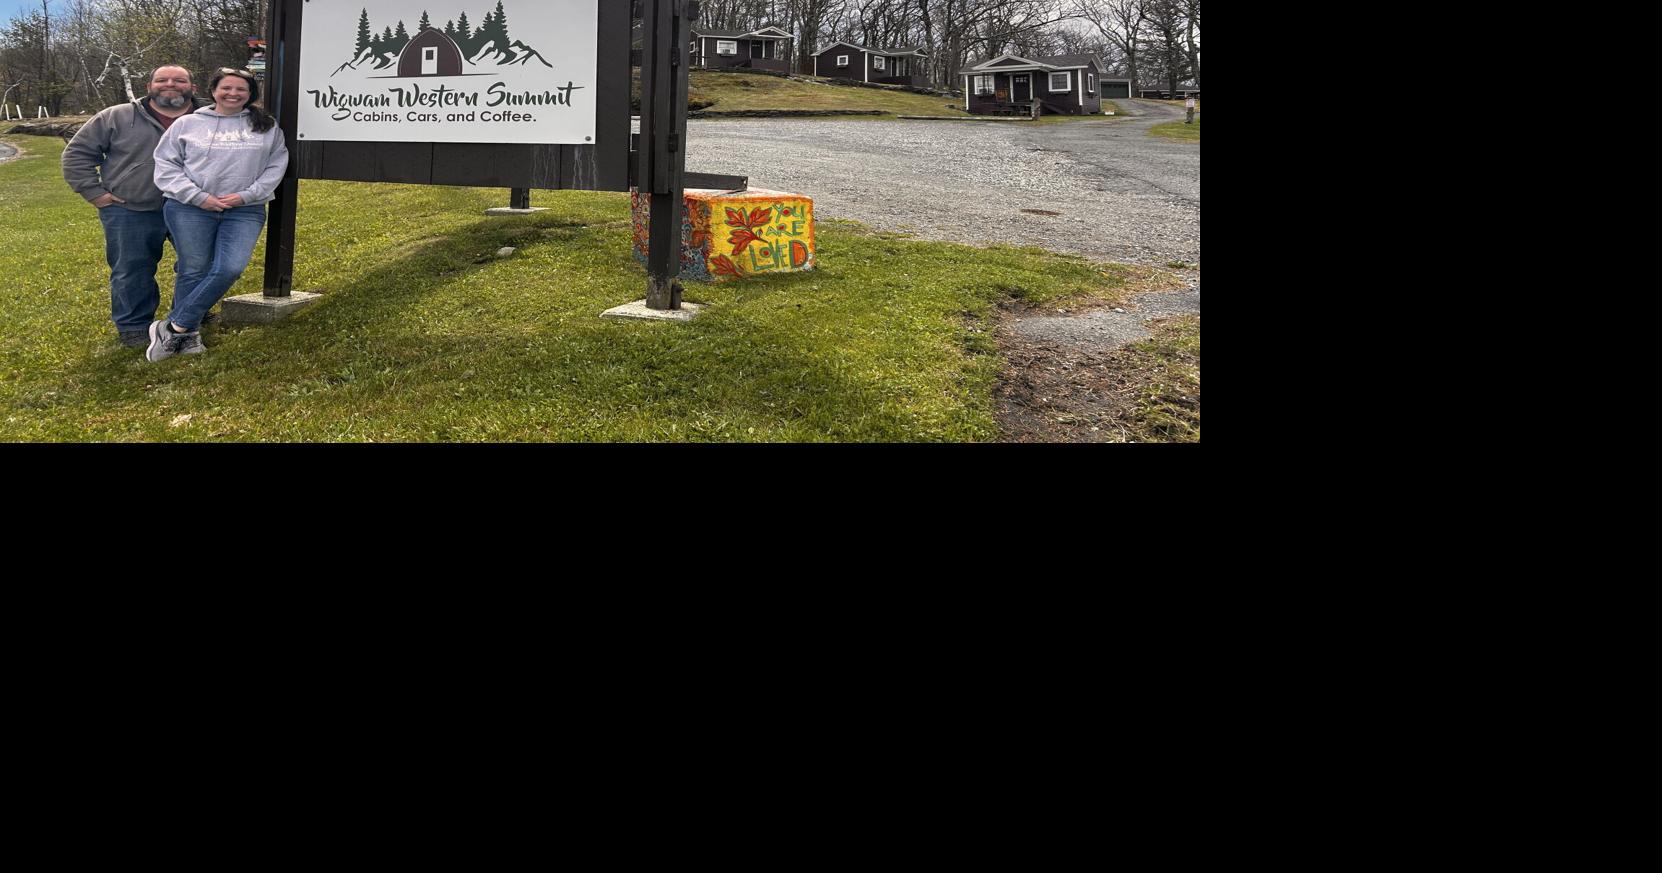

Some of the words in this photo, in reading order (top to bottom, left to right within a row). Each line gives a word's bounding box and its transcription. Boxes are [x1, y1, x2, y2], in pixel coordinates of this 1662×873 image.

[307, 85, 390, 121] Wigwam
[388, 83, 478, 108] Western
[486, 81, 585, 107] Summit
[353, 111, 401, 123] Cabins,
[406, 111, 441, 123] Cars,
[447, 110, 475, 122] and
[480, 110, 537, 122] Coffee.
[765, 220, 805, 237] ARE
[749, 238, 808, 271] LOVED
